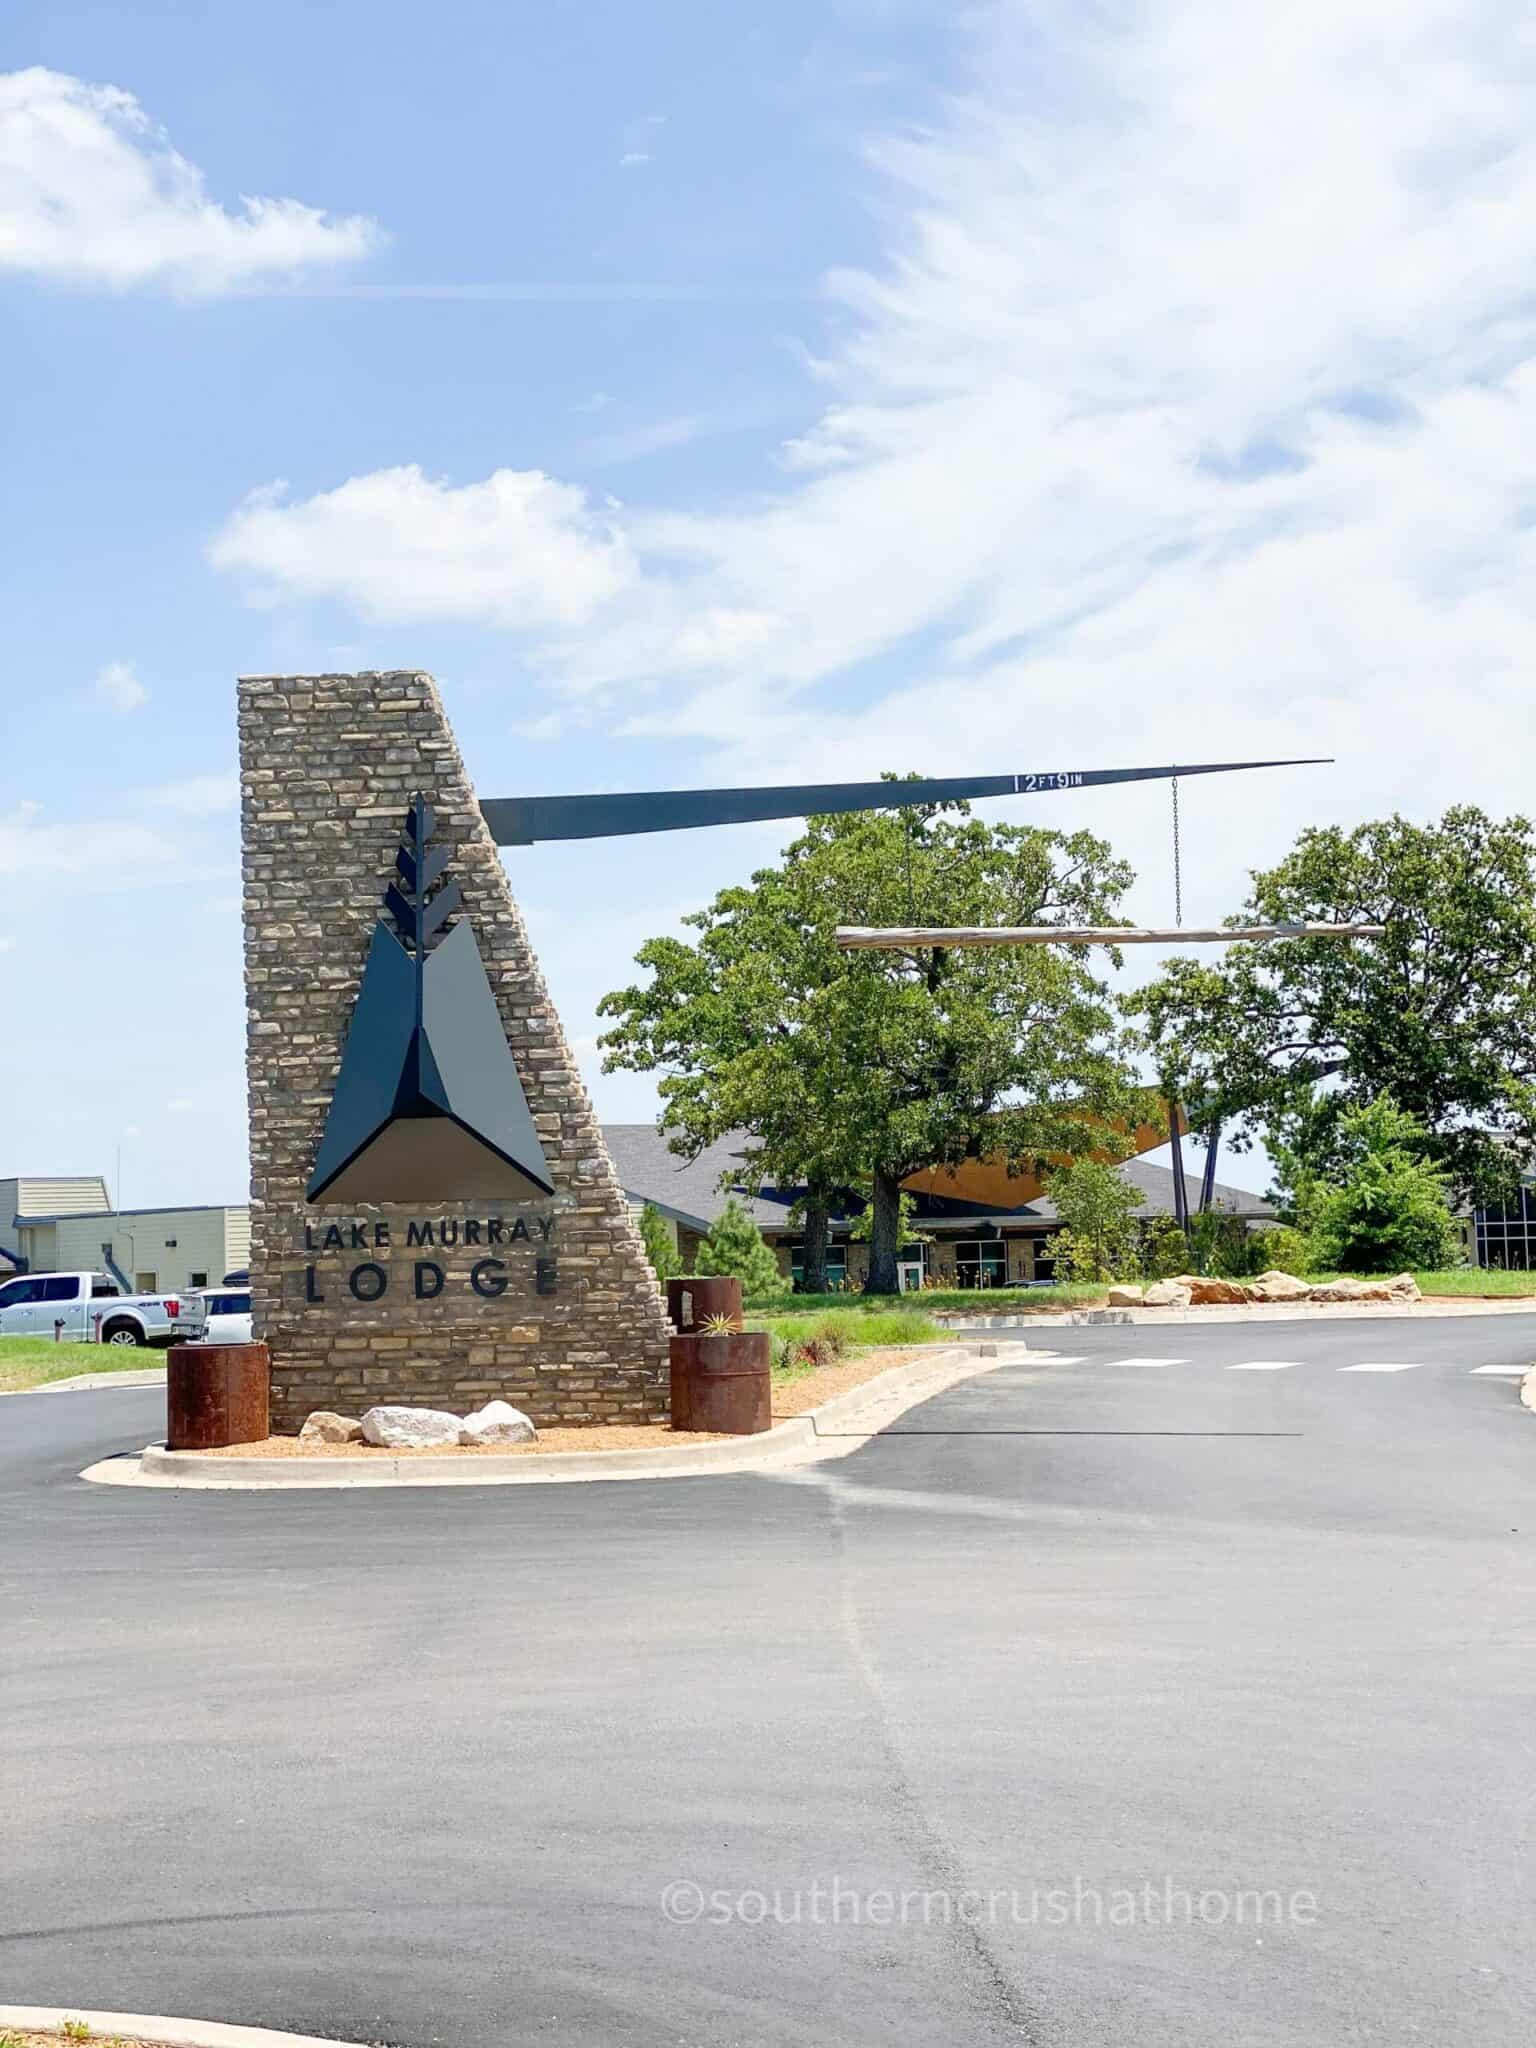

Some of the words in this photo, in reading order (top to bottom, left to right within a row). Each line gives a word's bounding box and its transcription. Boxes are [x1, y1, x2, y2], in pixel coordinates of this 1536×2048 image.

[305, 1222, 390, 1250] LAKE
[406, 1216, 552, 1247] MURRAY
[306, 1258, 557, 1303] LODGE
